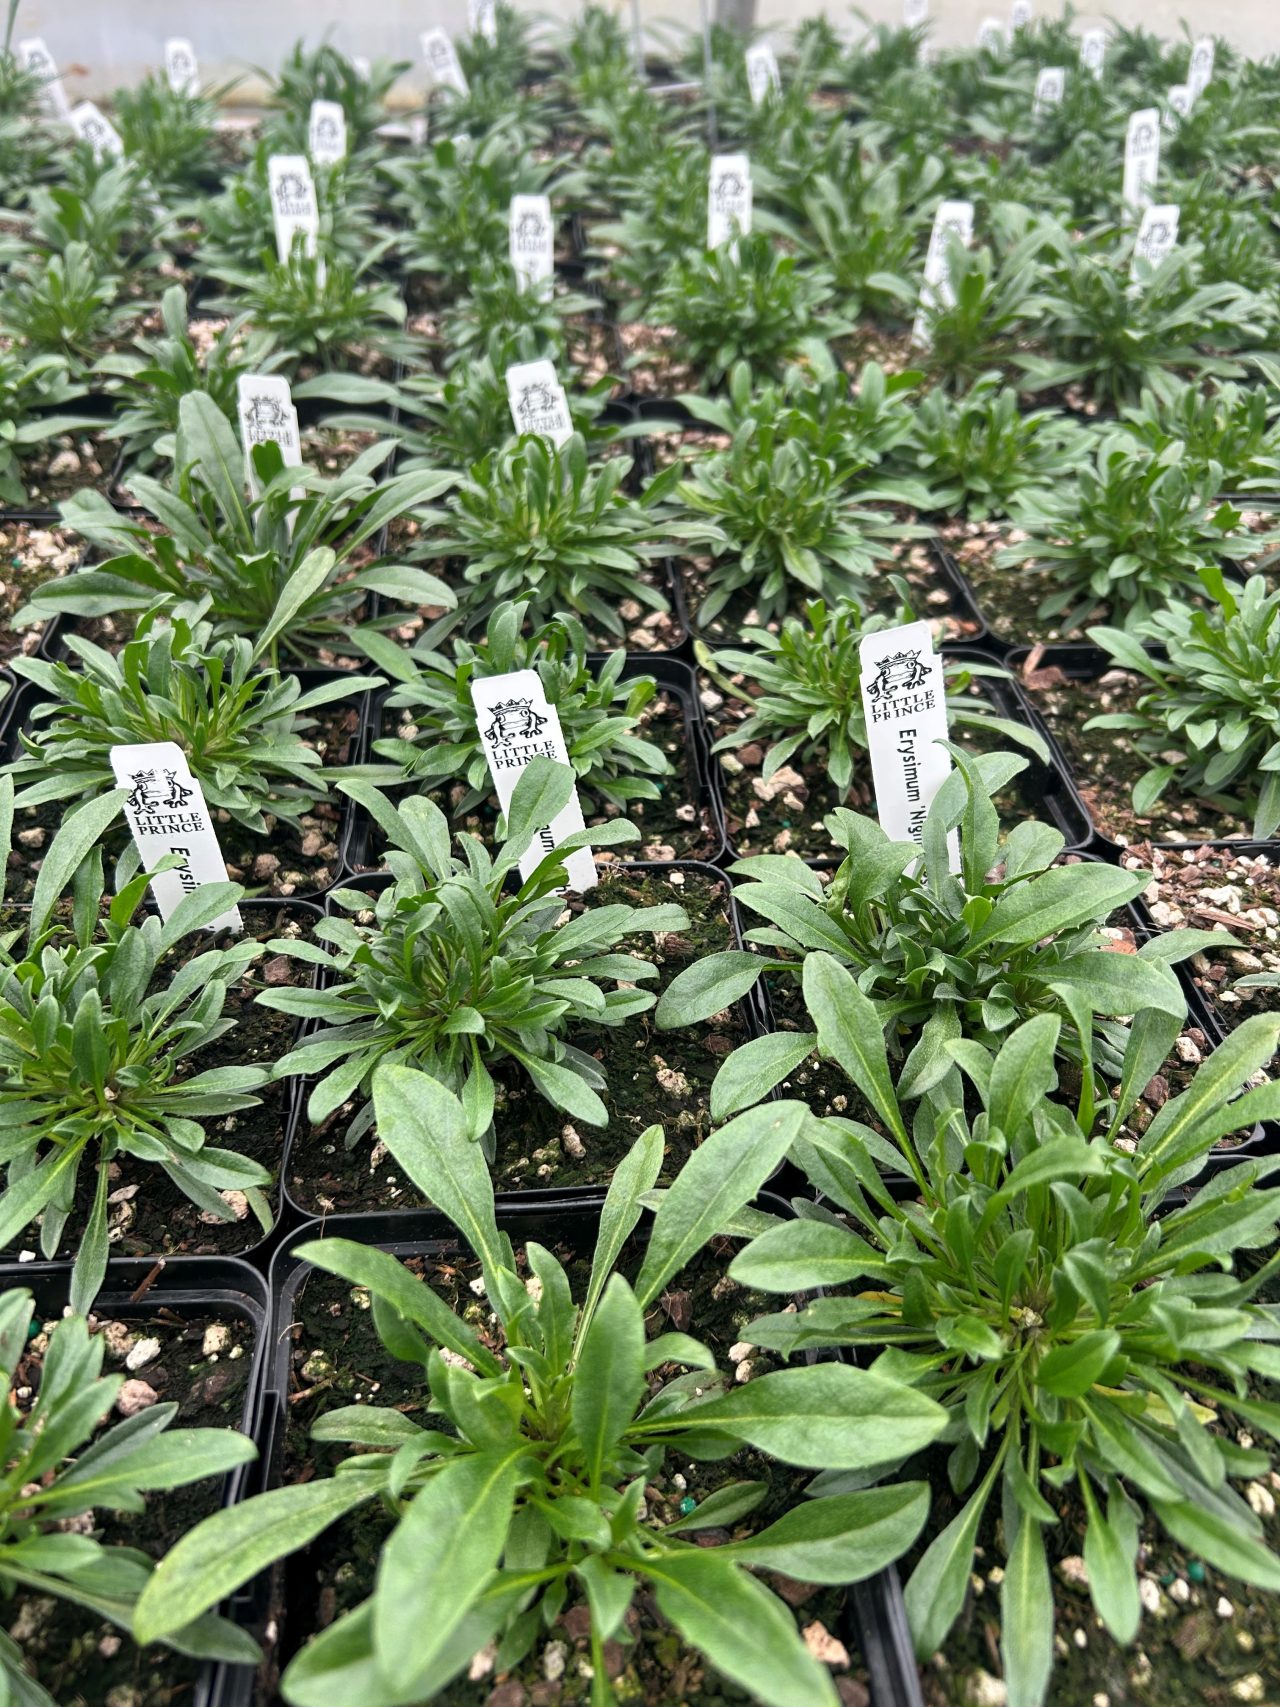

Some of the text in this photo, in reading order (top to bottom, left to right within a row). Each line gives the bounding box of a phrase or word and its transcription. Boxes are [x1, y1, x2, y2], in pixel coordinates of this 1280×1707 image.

[871, 690, 935, 714] LITTLE
[872, 700, 936, 723] PRINCE
[492, 740, 555, 760] LITTLE
[495, 750, 557, 769] PRINE
[897, 728, 922, 802] Erysimum
[134, 812, 201, 826] LITTLE
[138, 822, 205, 835] PRINCE
